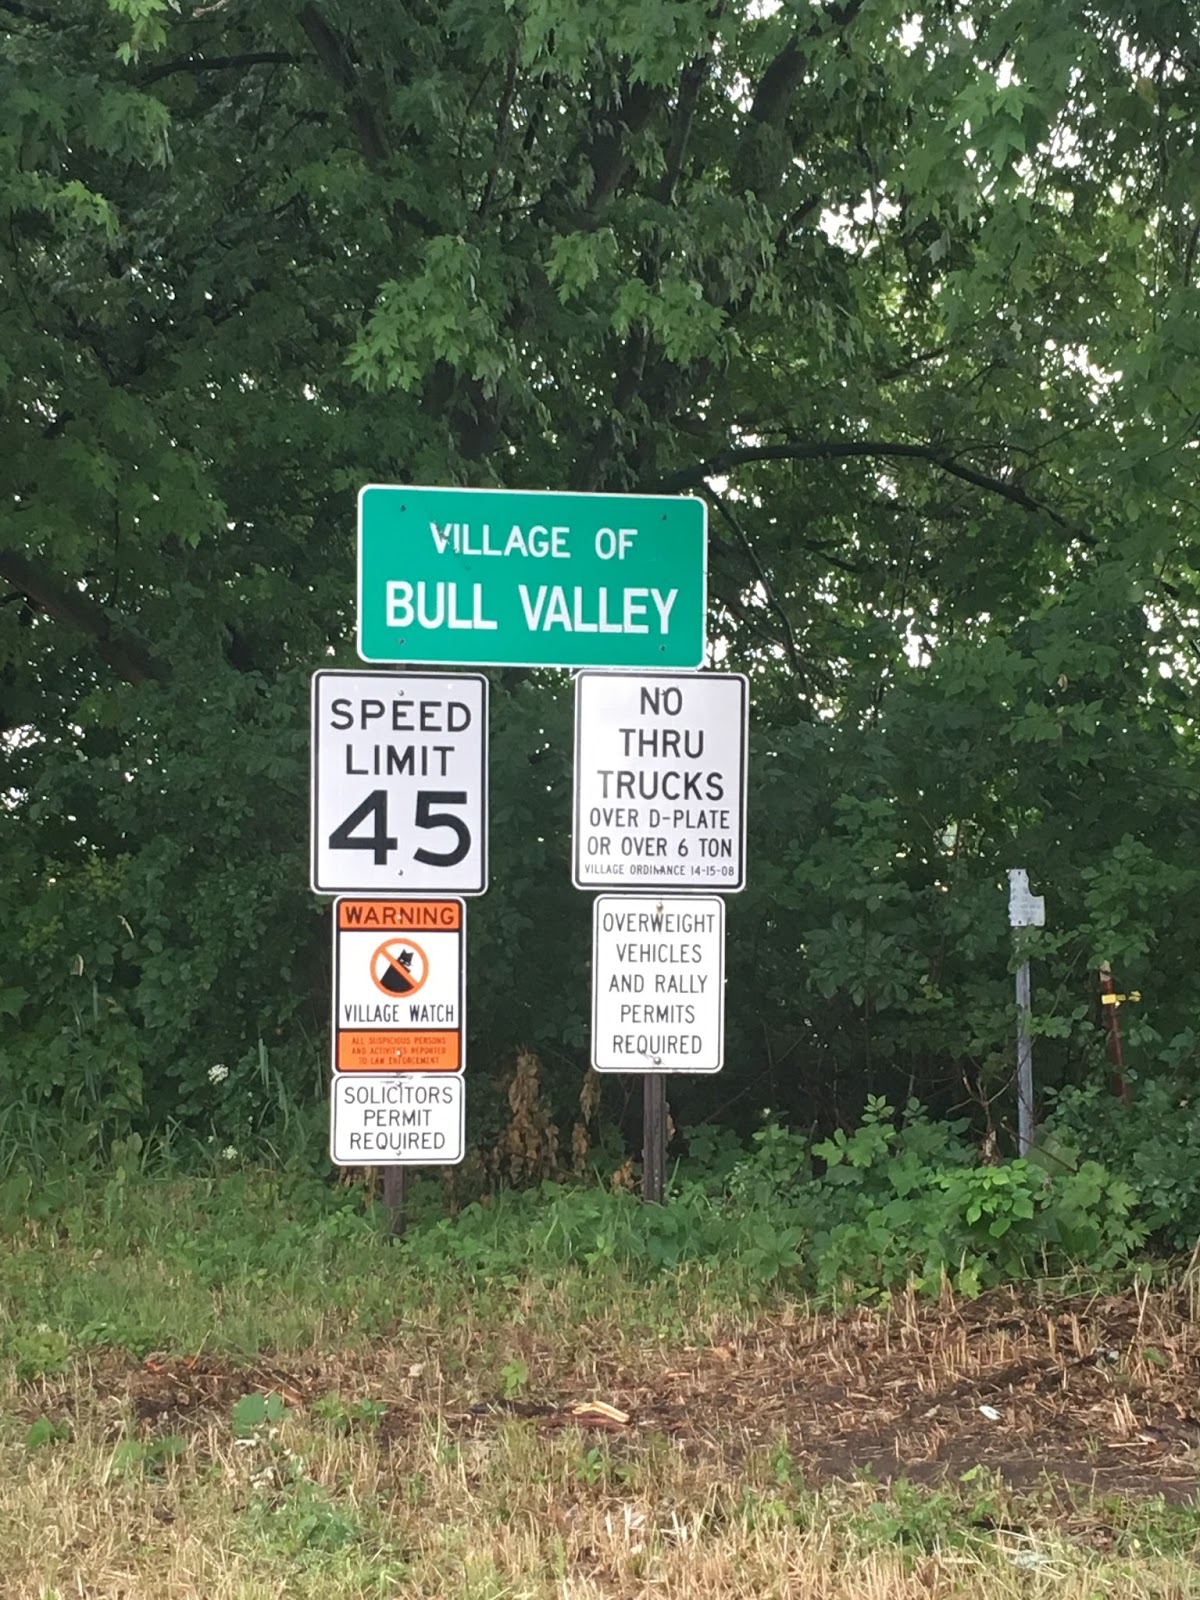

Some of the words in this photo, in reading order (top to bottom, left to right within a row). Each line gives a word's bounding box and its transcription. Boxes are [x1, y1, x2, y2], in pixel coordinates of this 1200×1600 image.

[430, 522, 571, 558] VILLAGE
[595, 528, 638, 560] OF
[386, 580, 498, 630] BULL
[518, 585, 679, 635] VALLEY
[640, 687, 683, 716] NO
[330, 698, 471, 732] SPEED
[619, 728, 704, 759] THRU
[346, 744, 455, 776] LIMIT
[597, 770, 724, 801] TRUCKS
[590, 807, 639, 828] OVER
[650, 809, 730, 829] D-PLATE
[328, 790, 472, 867] 45
[587, 836, 611, 855] OR
[621, 837, 667, 857] OVER
[678, 838, 689, 857] 6
[699, 838, 732, 857] TON
[585, 864, 625, 875] VILLAGE
[630, 865, 686, 876] ORDINANCE
[690, 866, 735, 877] 14-15-08
[345, 906, 455, 925] WARNING
[603, 913, 716, 933] OVERWEIGHT
[616, 943, 702, 963] VEHICLES
[609, 974, 644, 993] AND
[655, 974, 708, 993] RALLY
[344, 1004, 399, 1022] VILLAGE
[409, 1004, 454, 1022] WATCH
[621, 1004, 695, 1024] PERMITS
[352, 1037, 365, 1045] ALL
[352, 1047, 366, 1055] AND
[613, 1035, 702, 1055] REQUIRED
[344, 1086, 453, 1104] SOLICITORS
[364, 1109, 432, 1126] PERMIT
[350, 1132, 446, 1150] REQUIRED
